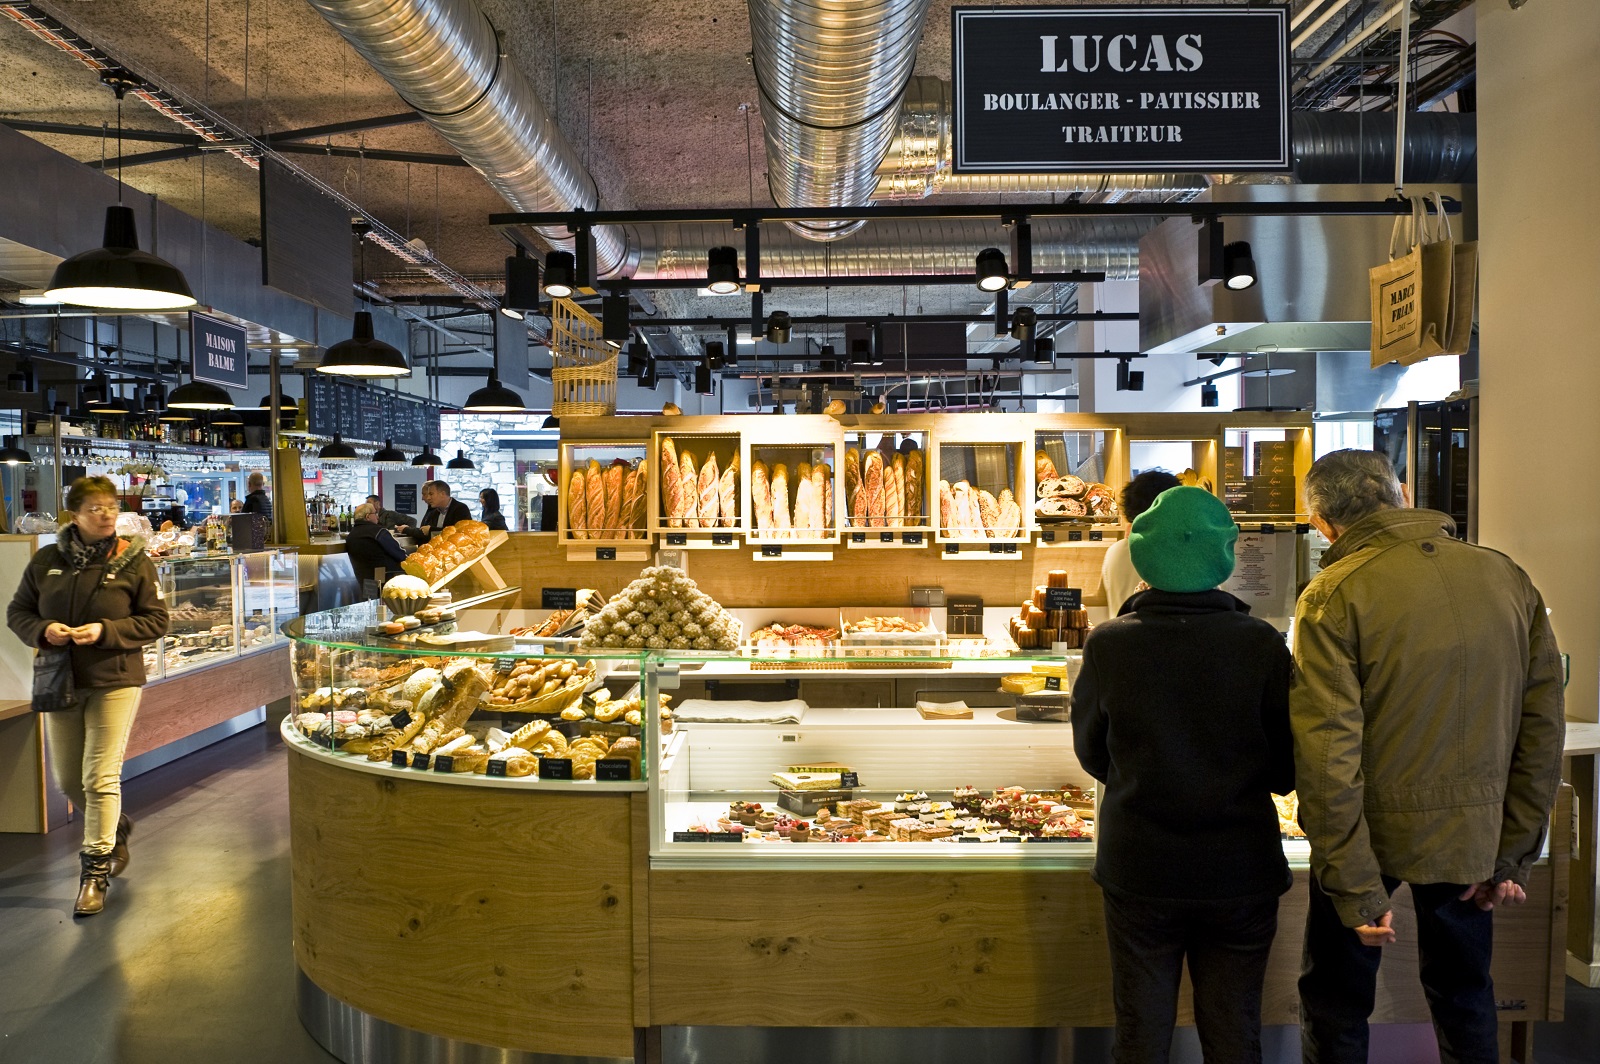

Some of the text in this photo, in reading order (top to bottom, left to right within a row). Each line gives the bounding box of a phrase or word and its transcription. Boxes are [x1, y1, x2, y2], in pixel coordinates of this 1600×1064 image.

[1040, 34, 1204, 73] LUCAS
[983, 92, 1121, 111] BOULANGER
[1139, 91, 1261, 110] PATISSIER
[1062, 125, 1183, 143] TRAITEUR
[205, 332, 236, 354] MAISON
[208, 352, 235, 372] BALME
